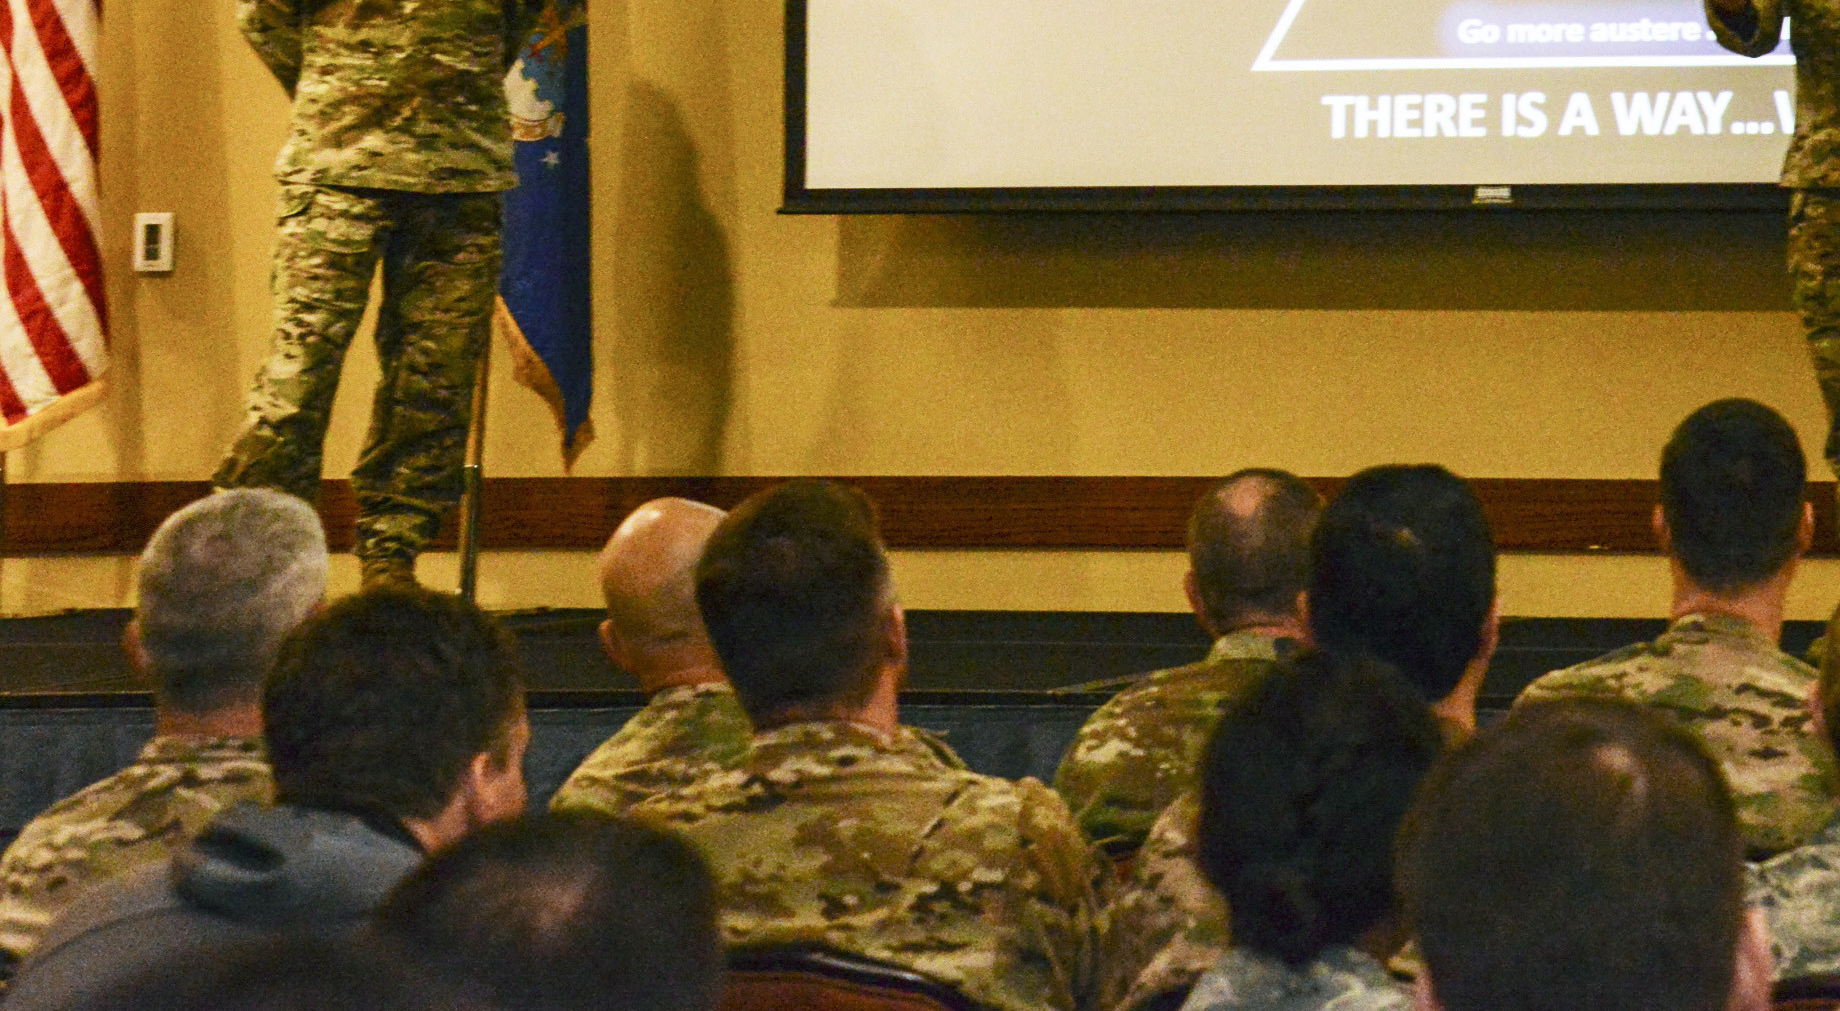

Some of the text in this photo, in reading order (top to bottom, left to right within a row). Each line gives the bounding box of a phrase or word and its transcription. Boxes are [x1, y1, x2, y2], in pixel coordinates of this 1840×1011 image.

[1457, 18, 1501, 44] Go
[1507, 22, 1586, 44] more
[1590, 17, 1702, 42] austere
[1321, 93, 1487, 138] THERE
[1501, 91, 1548, 138] IS
[1558, 92, 1599, 136] A
